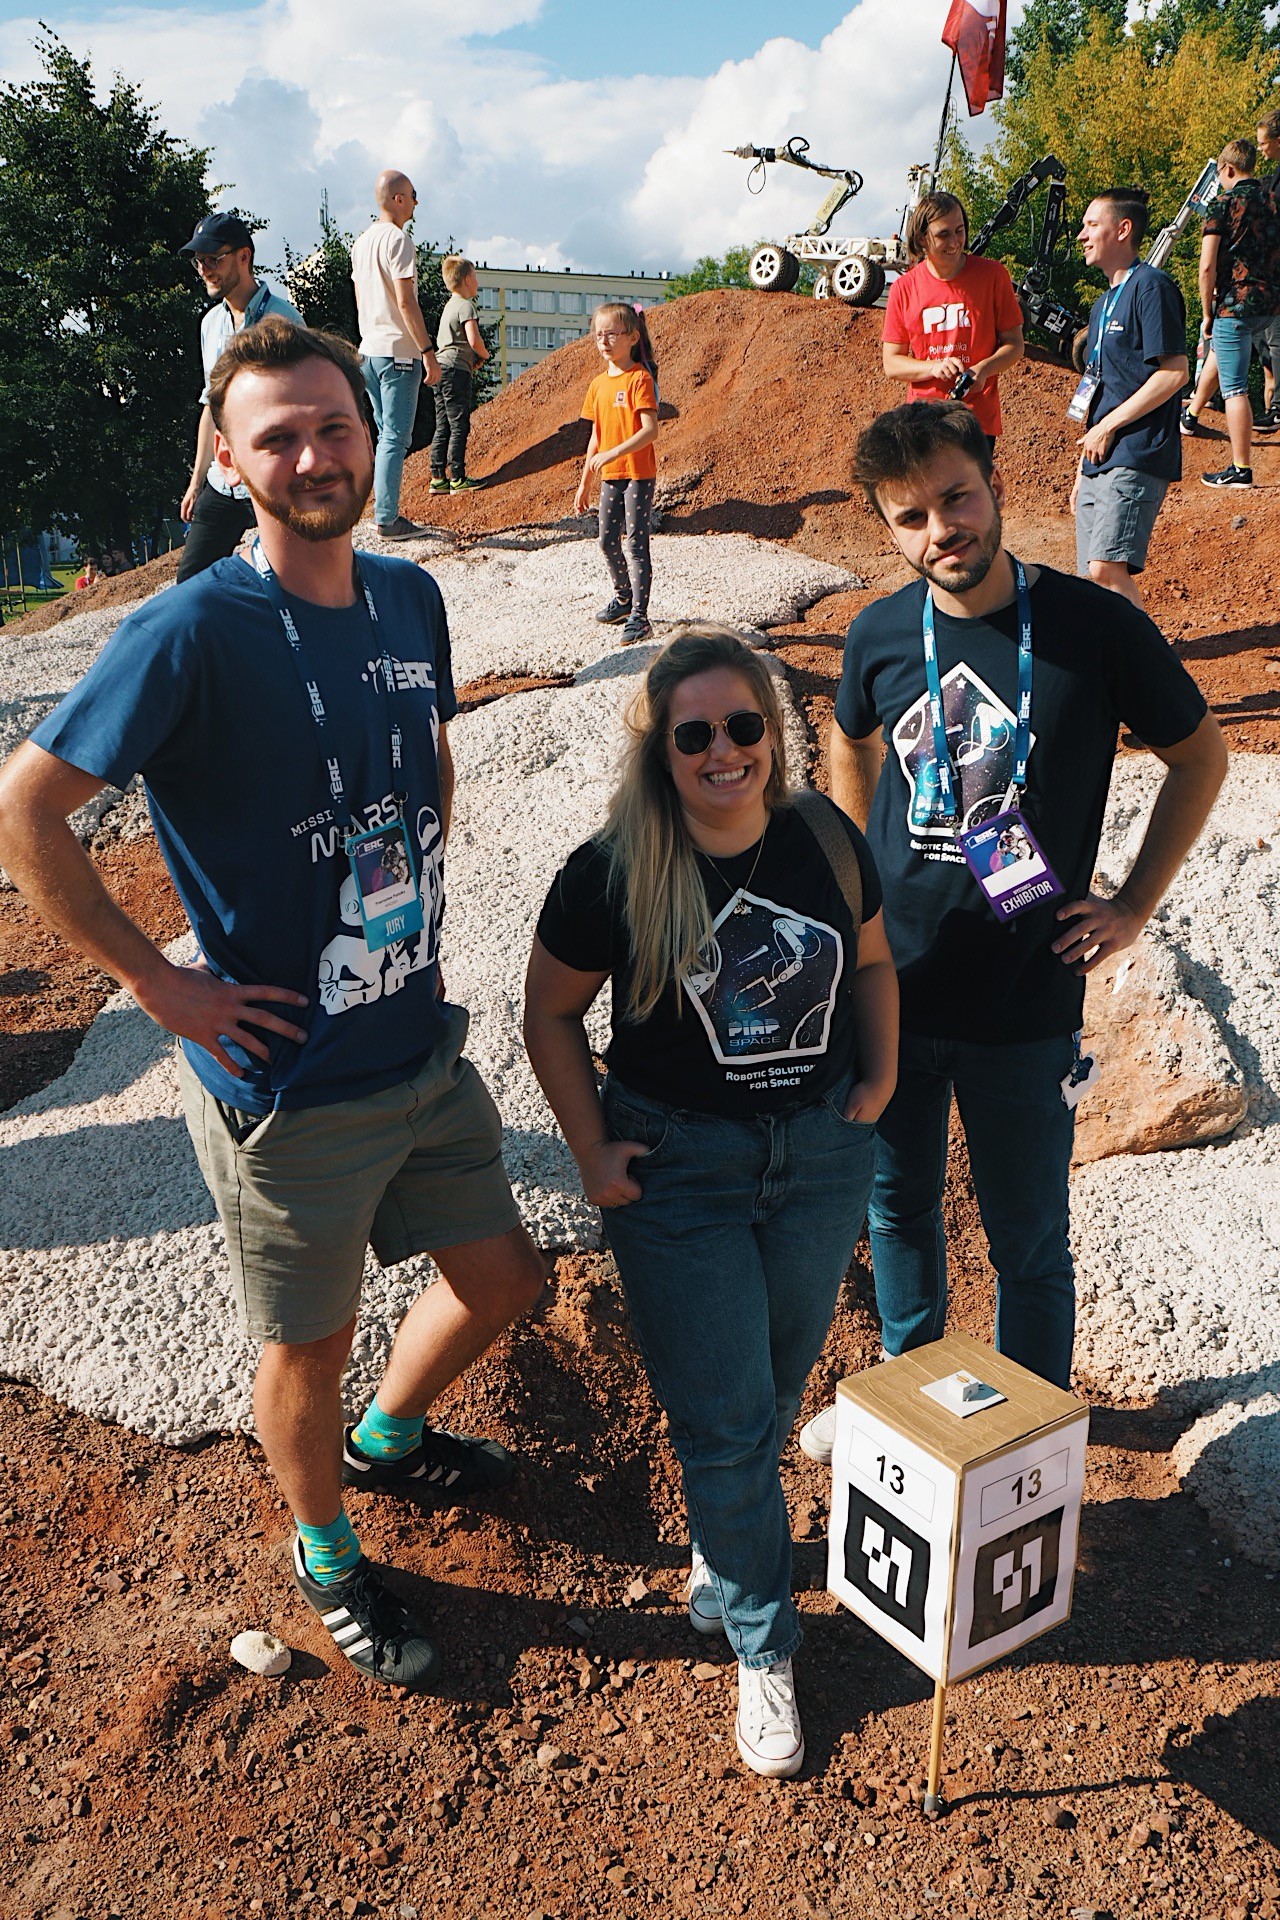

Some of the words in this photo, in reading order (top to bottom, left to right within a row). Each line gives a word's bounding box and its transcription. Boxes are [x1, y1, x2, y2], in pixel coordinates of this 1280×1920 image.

[363, 587, 378, 622] ERC
[279, 607, 300, 642] ERC
[1021, 622, 1031, 650] ERC
[382, 658, 396, 692] ERC
[393, 661, 437, 690] ERC
[306, 680, 325, 717] ERC
[1021, 691, 1031, 719] ERC
[930, 701, 941, 728] ERC
[391, 734, 402, 769] ERC
[327, 757, 344, 794] ERC
[290, 809, 335, 837] MISSI
[915, 811, 946, 819] SPAC
[364, 838, 385, 852] ERC
[942, 843, 962, 853] SOLU
[1001, 880, 1053, 913] EXHIBITOR
[385, 915, 405, 937] JURY
[728, 1018, 780, 1036] PIAP
[729, 1036, 780, 1047] SPACE
[876, 1454, 906, 1495] 13
[1011, 1468, 1042, 1505] 13
